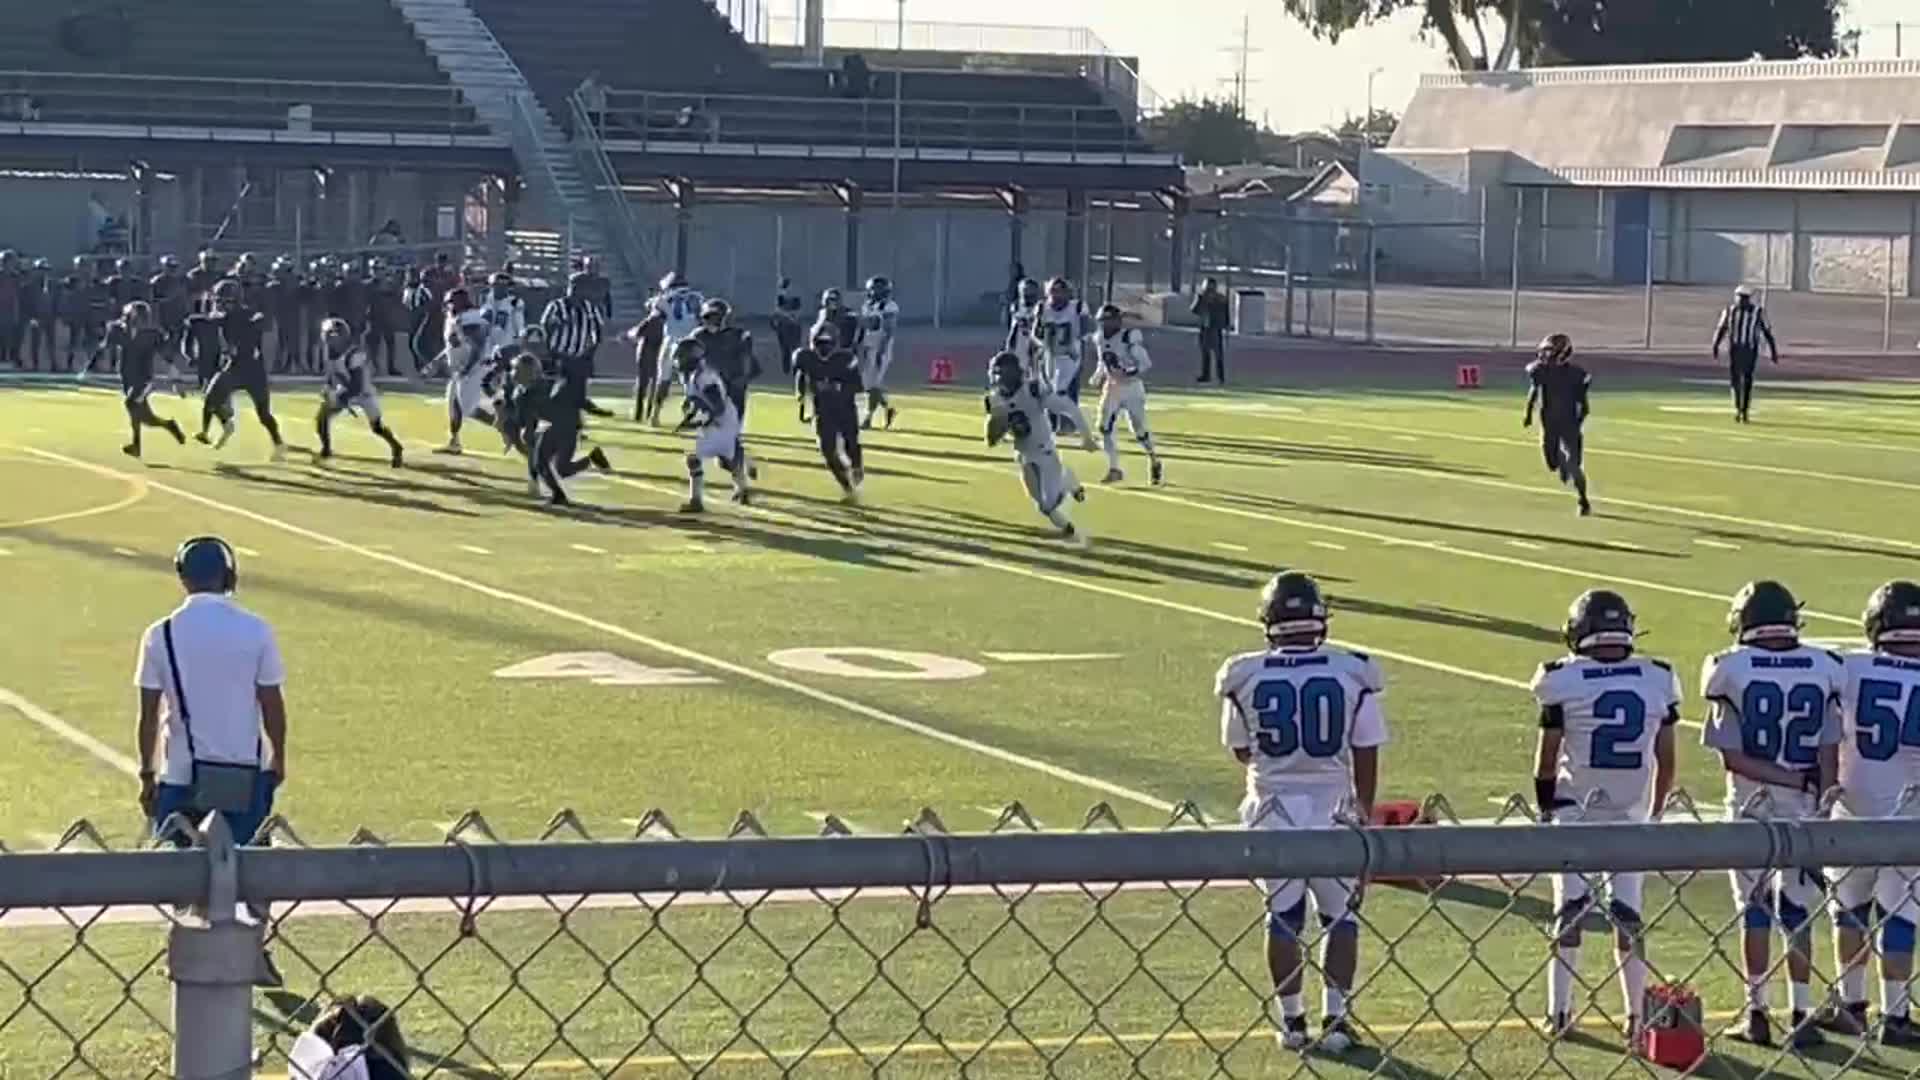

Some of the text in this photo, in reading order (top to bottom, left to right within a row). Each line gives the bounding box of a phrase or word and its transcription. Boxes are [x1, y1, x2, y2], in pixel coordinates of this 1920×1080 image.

[1252, 676, 1345, 758] 30
[1590, 689, 1646, 769] 2
[1742, 679, 1825, 764] 82
